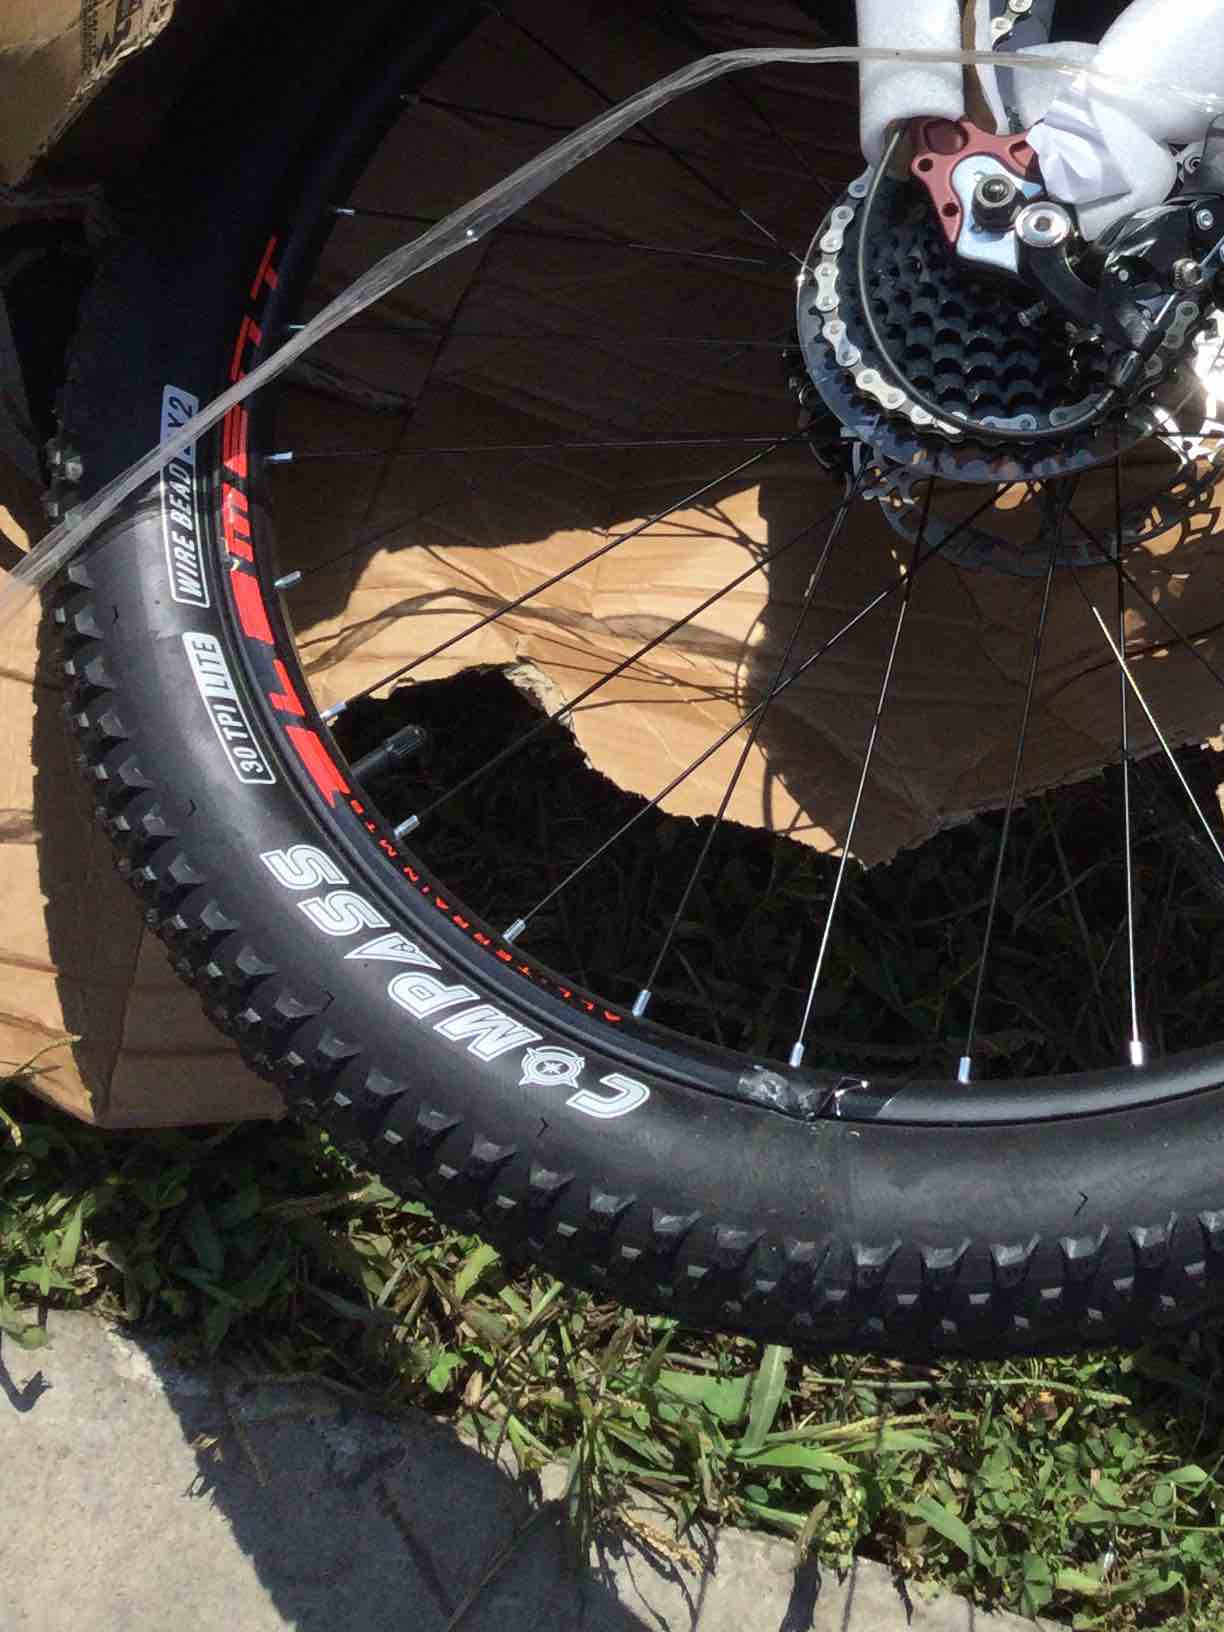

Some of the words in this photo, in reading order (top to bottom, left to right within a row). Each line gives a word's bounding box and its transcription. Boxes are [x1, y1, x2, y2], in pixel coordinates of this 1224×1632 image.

[168, 463, 195, 525] BEAD
[168, 524, 204, 599] WIRE
[196, 640, 230, 695] LITE
[212, 698, 248, 743] TPI
[234, 744, 266, 776] 30
[259, 843, 652, 1120] COMPASS
